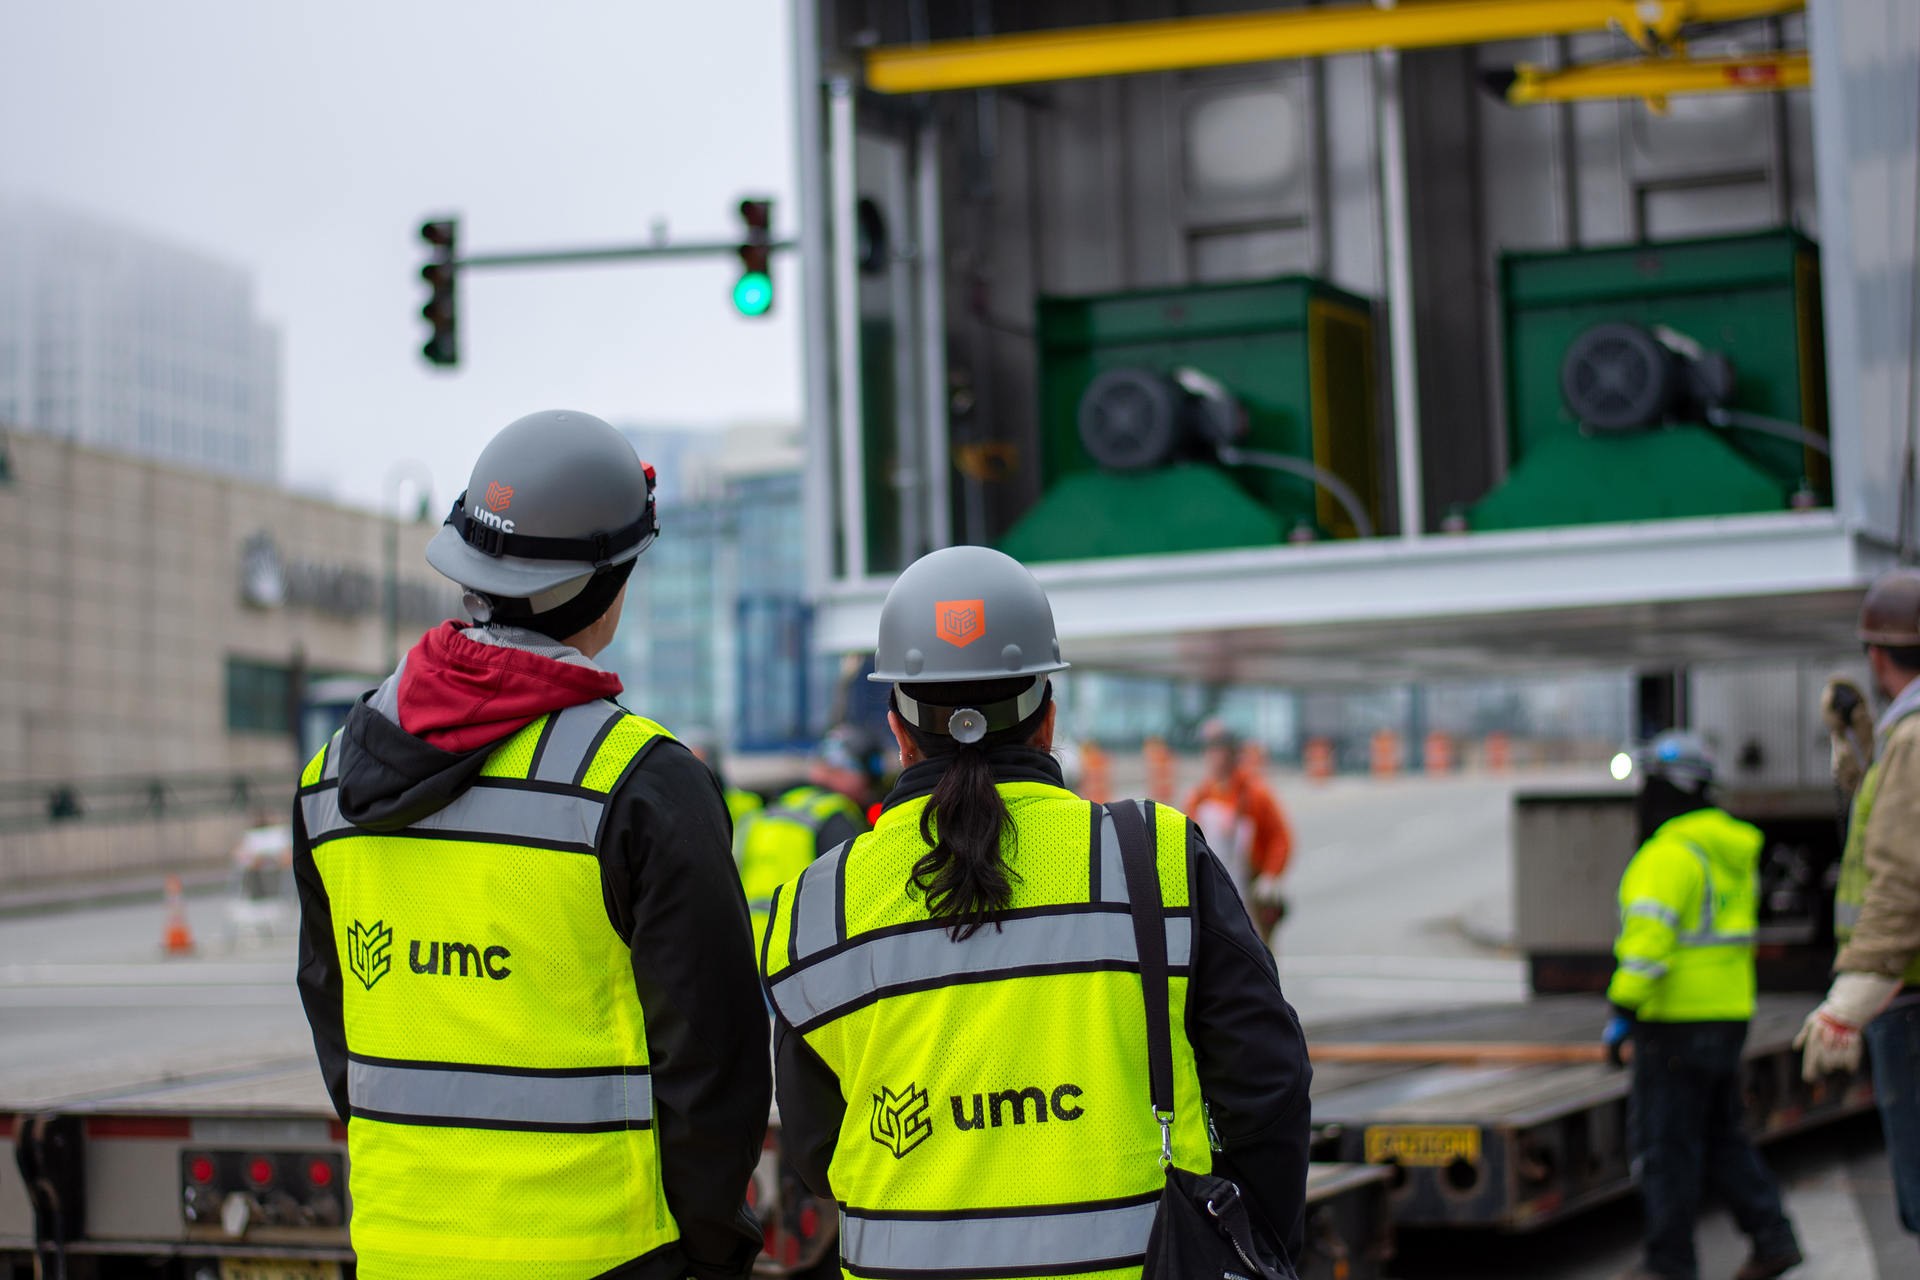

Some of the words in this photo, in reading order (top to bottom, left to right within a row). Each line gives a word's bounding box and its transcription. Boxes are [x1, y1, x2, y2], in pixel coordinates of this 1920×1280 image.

[474, 505, 516, 534] umc
[408, 939, 512, 981] umc
[949, 1083, 1085, 1132] umc
